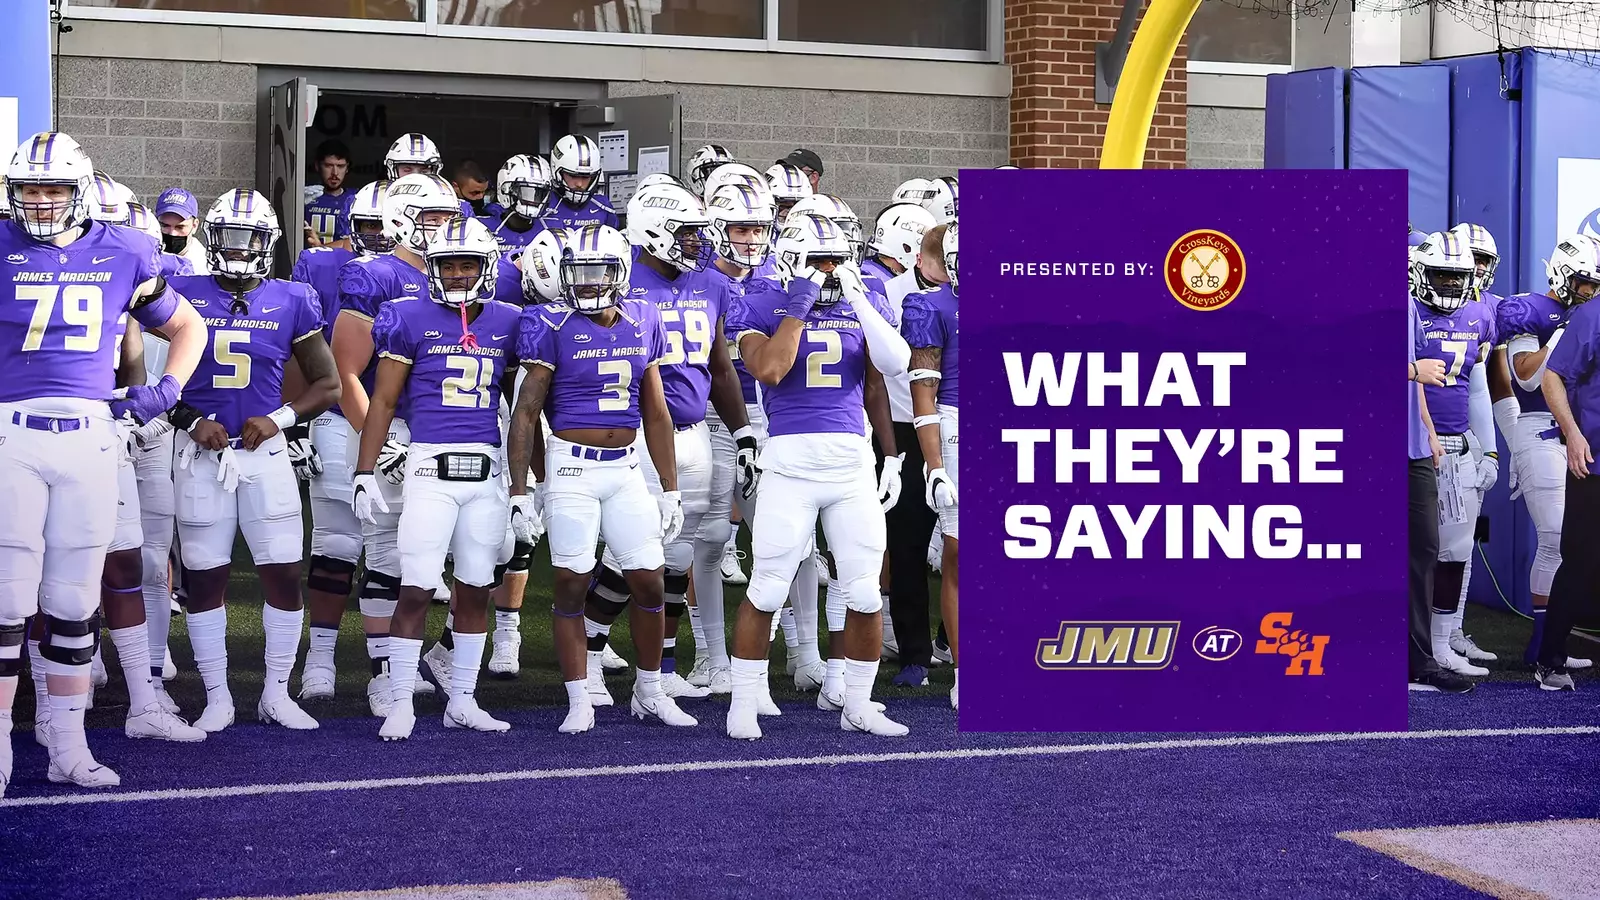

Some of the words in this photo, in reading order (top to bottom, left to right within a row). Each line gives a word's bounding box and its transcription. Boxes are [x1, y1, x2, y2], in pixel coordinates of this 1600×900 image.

[643, 196, 680, 210] JMU
[7, 254, 25, 262] CAA
[12, 271, 53, 283] JAMES
[58, 271, 112, 283] MADISON
[191, 298, 206, 306] CAA
[14, 284, 103, 353] 79
[231, 319, 279, 330] MADISON
[817, 320, 860, 330] MADISON
[658, 310, 711, 365] 59
[428, 345, 462, 354] JAMES
[572, 348, 608, 360] JAMES
[212, 330, 251, 389] 5
[806, 330, 843, 388] 2
[1441, 341, 1467, 386] 7
[442, 356, 494, 409] 21
[597, 360, 633, 412] 3
[557, 467, 583, 476] JMU
